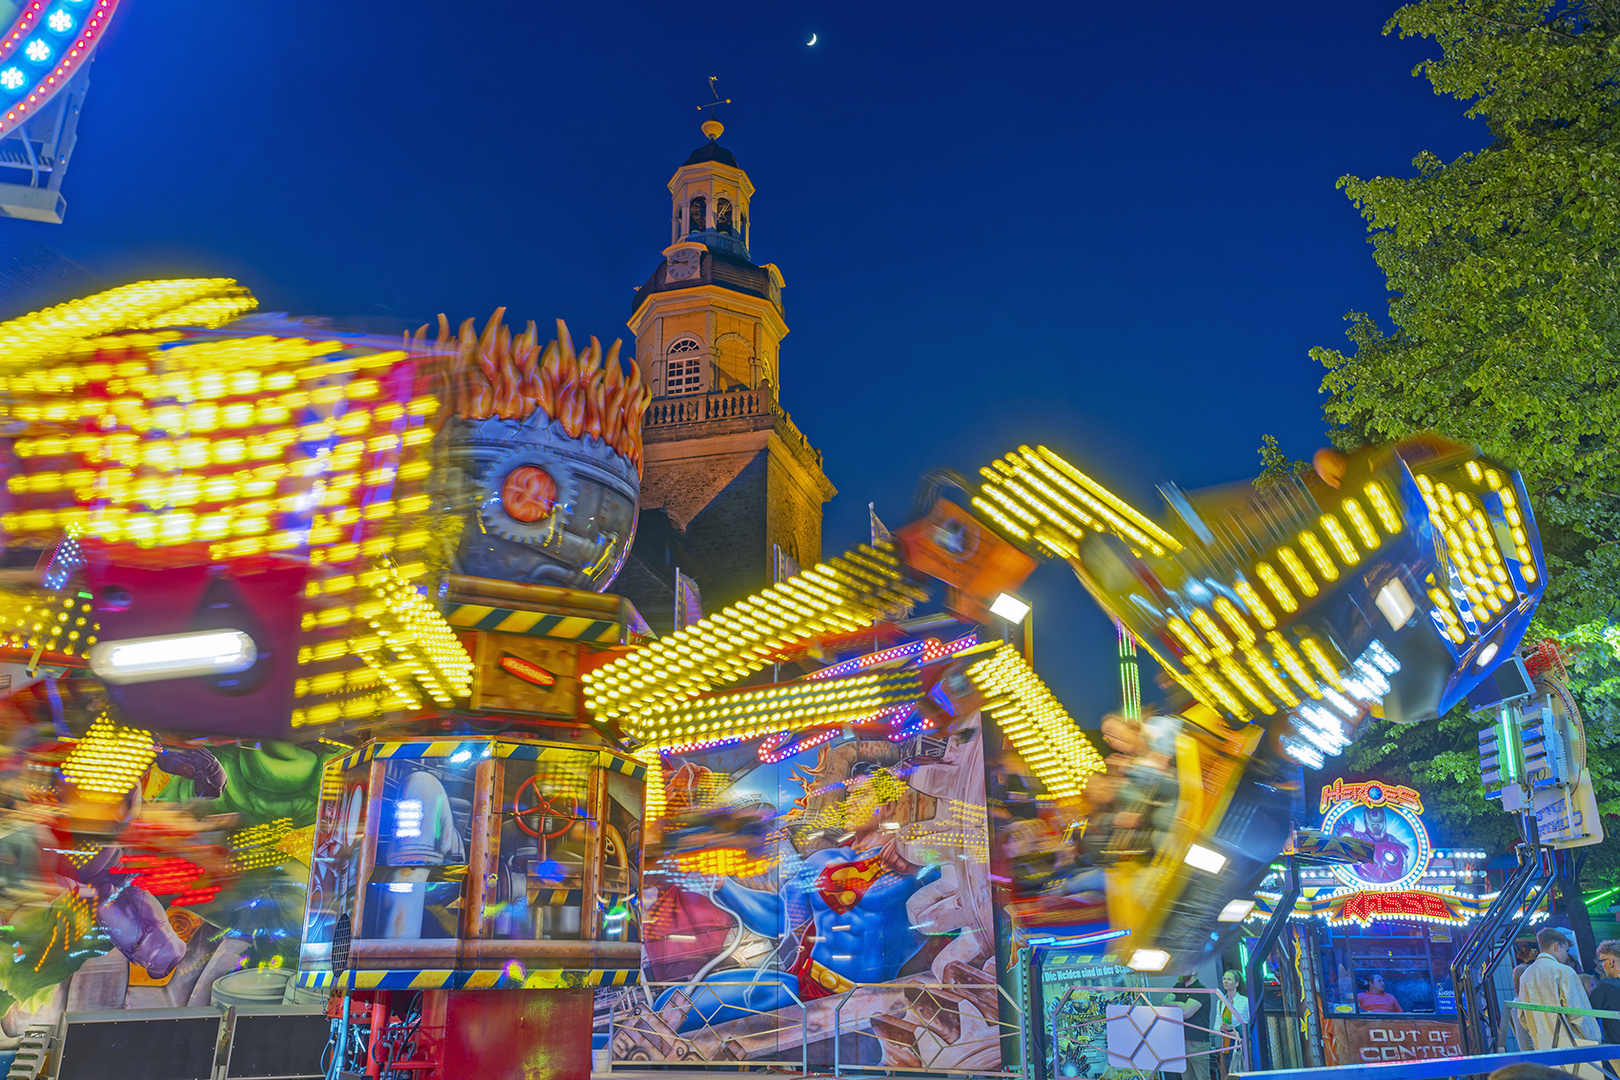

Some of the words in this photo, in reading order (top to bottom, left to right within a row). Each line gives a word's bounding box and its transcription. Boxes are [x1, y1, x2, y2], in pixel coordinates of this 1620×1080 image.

[1045, 971, 1057, 982] Die
[1081, 967, 1096, 979] sind
[1096, 966, 1103, 977] in
[1103, 965, 1115, 976] der
[1369, 1029, 1420, 1042] OUT
[1428, 1030, 1452, 1044] OF
